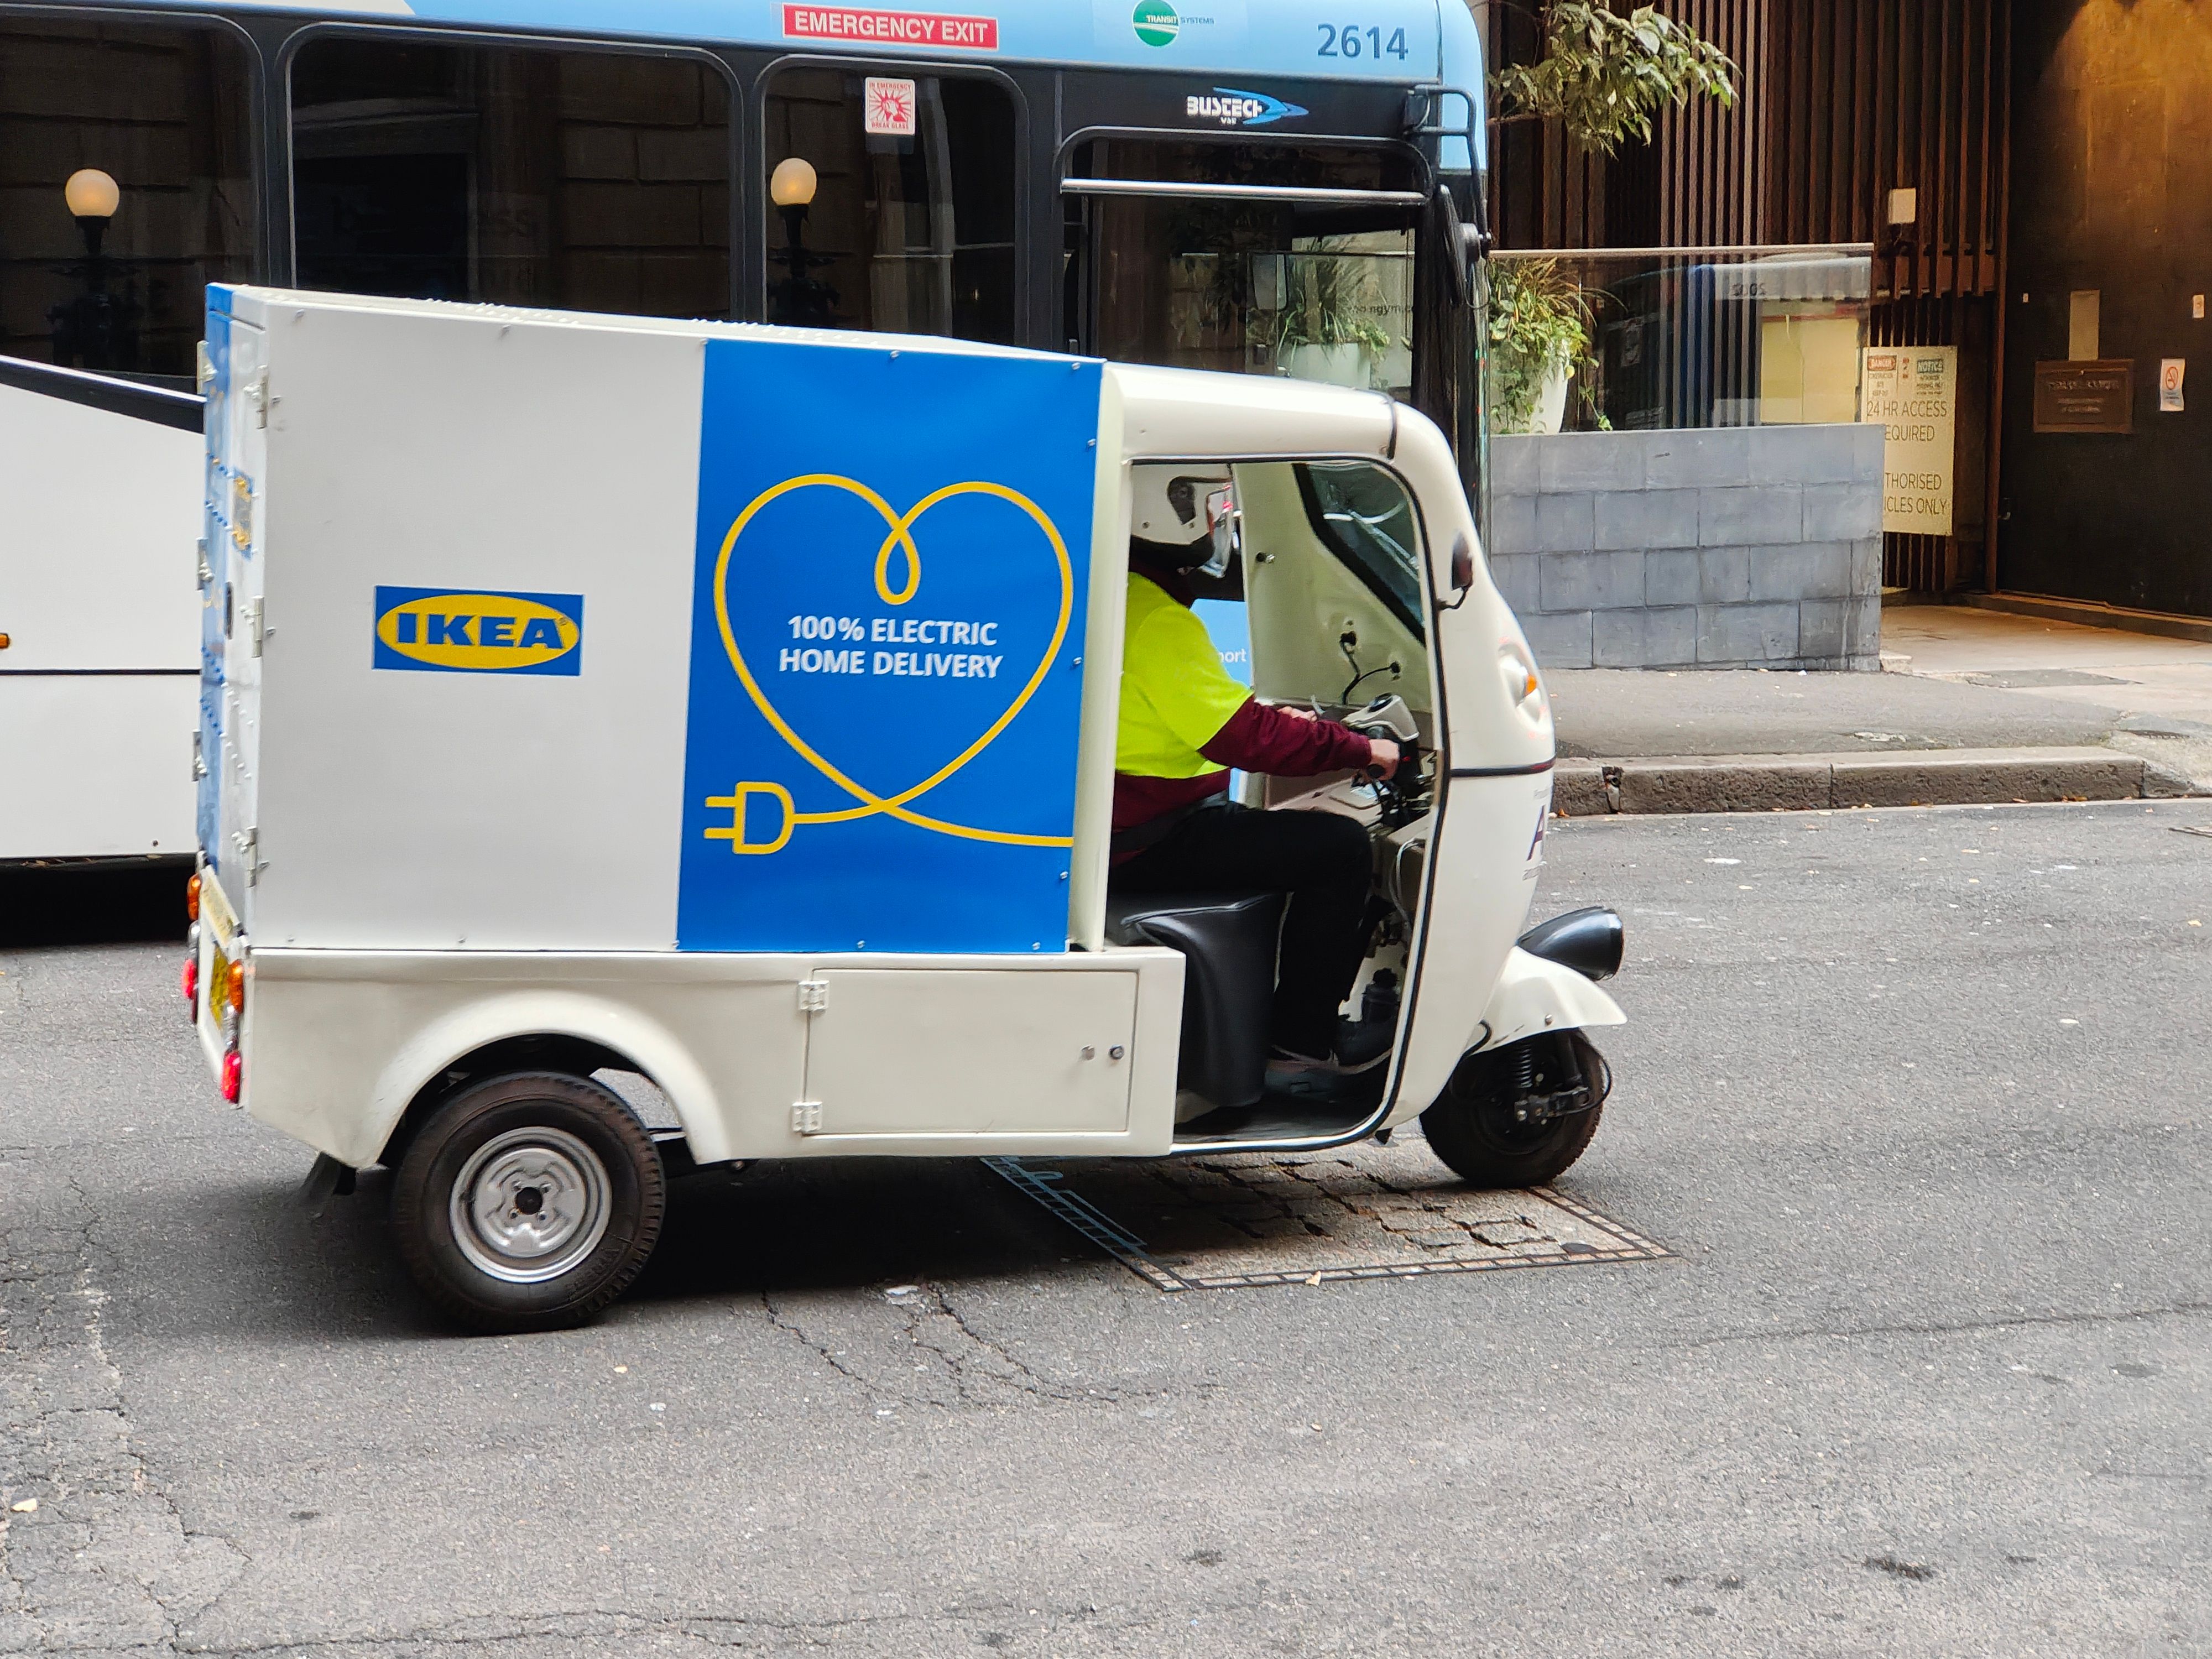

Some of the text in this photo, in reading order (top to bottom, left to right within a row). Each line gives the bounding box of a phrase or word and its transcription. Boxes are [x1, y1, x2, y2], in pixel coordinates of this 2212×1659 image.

[794, 10, 988, 43] EMERGENCY EXIT
[1146, 15, 1178, 24] TRANSIT
[1318, 23, 1408, 60] 2614
[1187, 96, 1263, 117] BUSTECH
[1917, 361, 1943, 372] NOTICE
[1867, 400, 1947, 418] 24 HR ACCESS
[1885, 425, 1936, 442] EQUIRED
[1885, 472, 1942, 491] THORISED
[1884, 495, 1948, 515] ICLES ONLY
[397, 612, 564, 649] IKEA
[787, 615, 999, 646] 100% ELECTRIC
[779, 648, 1004, 679] HOME DELIVERY
